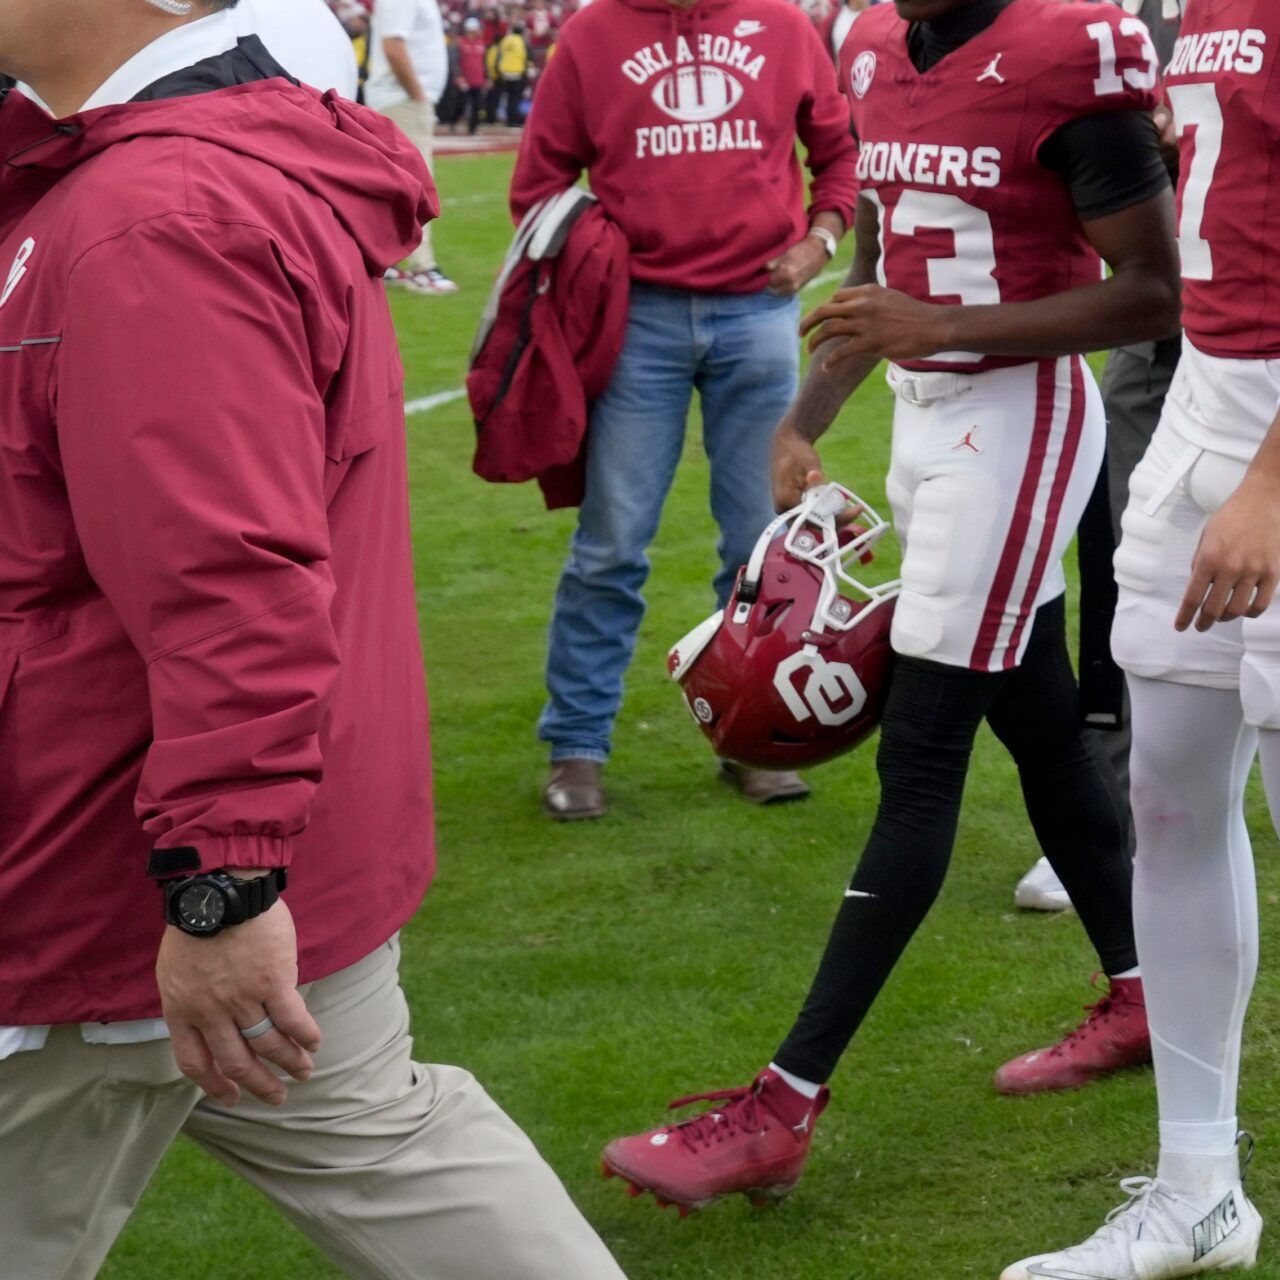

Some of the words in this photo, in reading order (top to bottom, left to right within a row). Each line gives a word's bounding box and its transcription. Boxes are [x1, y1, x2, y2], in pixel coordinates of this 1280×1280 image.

[621, 33, 766, 86] OKLAHOMA
[1086, 17, 1159, 97] 13
[636, 119, 762, 159] FOOTBALL
[1166, 82, 1224, 281] 7
[1191, 1190, 1241, 1263] NIKE
